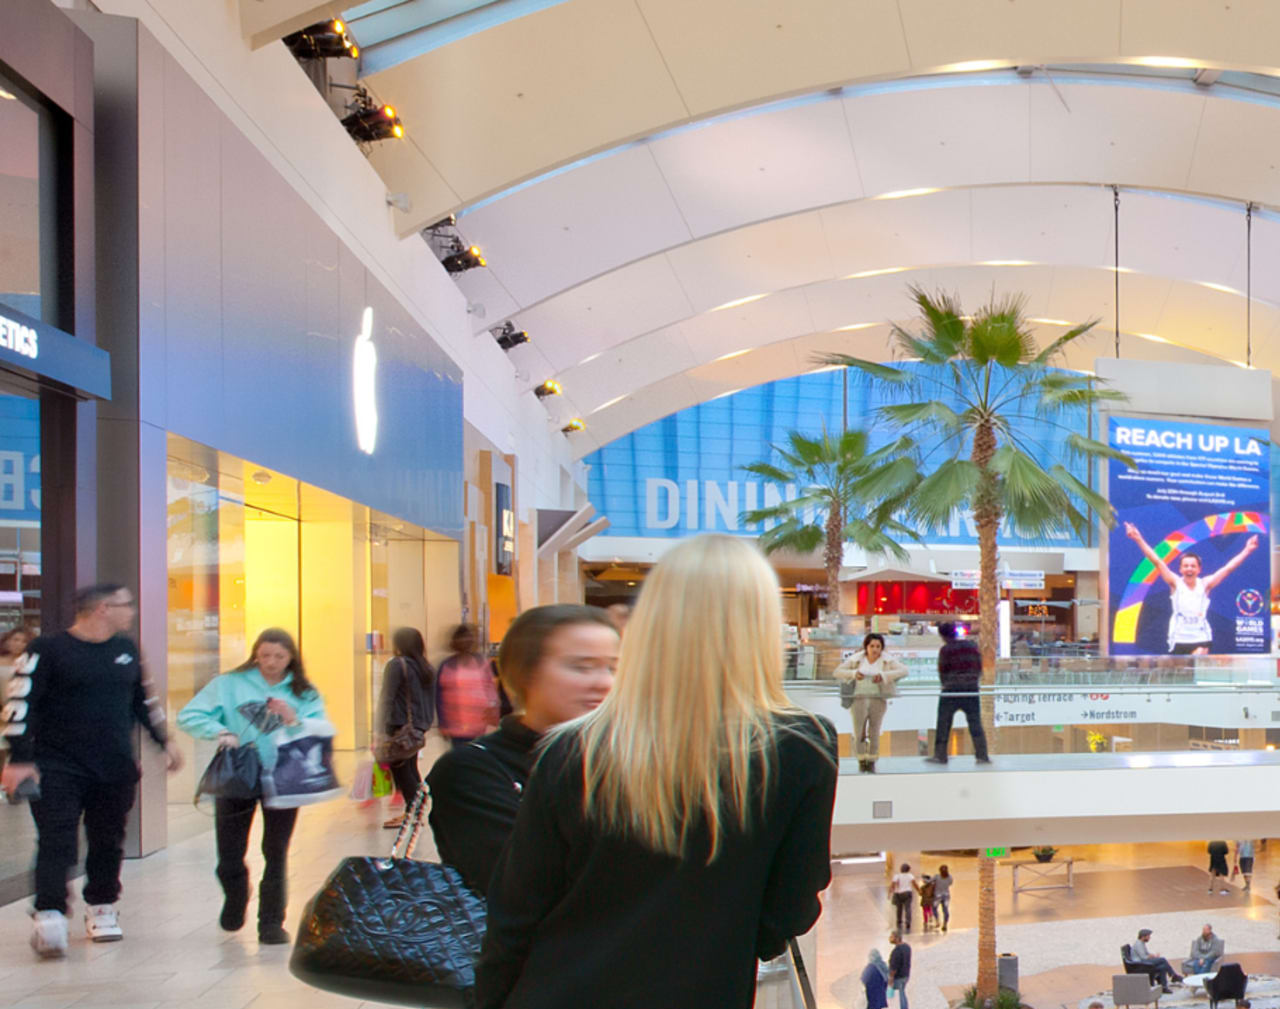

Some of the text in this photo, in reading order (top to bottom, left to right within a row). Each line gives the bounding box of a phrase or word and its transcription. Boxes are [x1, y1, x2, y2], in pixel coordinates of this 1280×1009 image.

[1115, 427, 1262, 456] REACH UP LA
[1004, 711, 1035, 723] Target
[1089, 709, 1137, 720] Nordstrom
